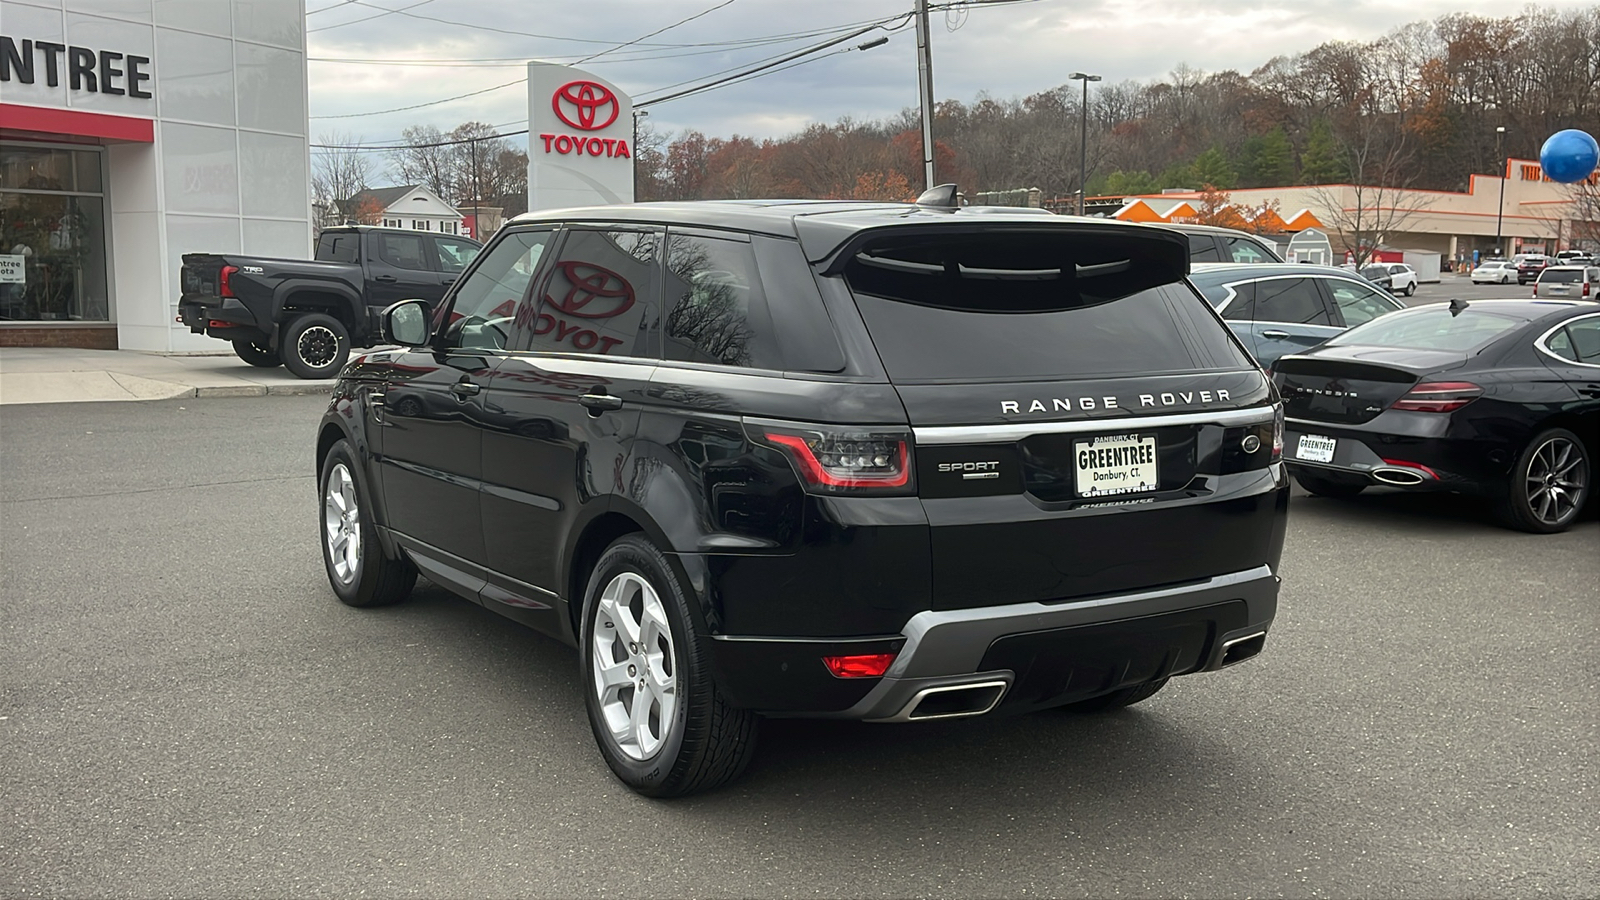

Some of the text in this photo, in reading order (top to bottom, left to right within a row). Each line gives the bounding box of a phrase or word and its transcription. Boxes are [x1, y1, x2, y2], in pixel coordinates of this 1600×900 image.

[0, 35, 152, 99] NTREE
[540, 134, 631, 158] TOYOTA
[1297, 387, 1358, 397] GENESIS
[1001, 389, 1231, 414] RANGE ROVER
[1300, 439, 1334, 451] GREENTREE
[1078, 444, 1153, 470] GREENTREE
[938, 461, 999, 472] SPORT
[1093, 467, 1141, 481] Danbury, CT.
[1082, 485, 1156, 497] GREENTREE
